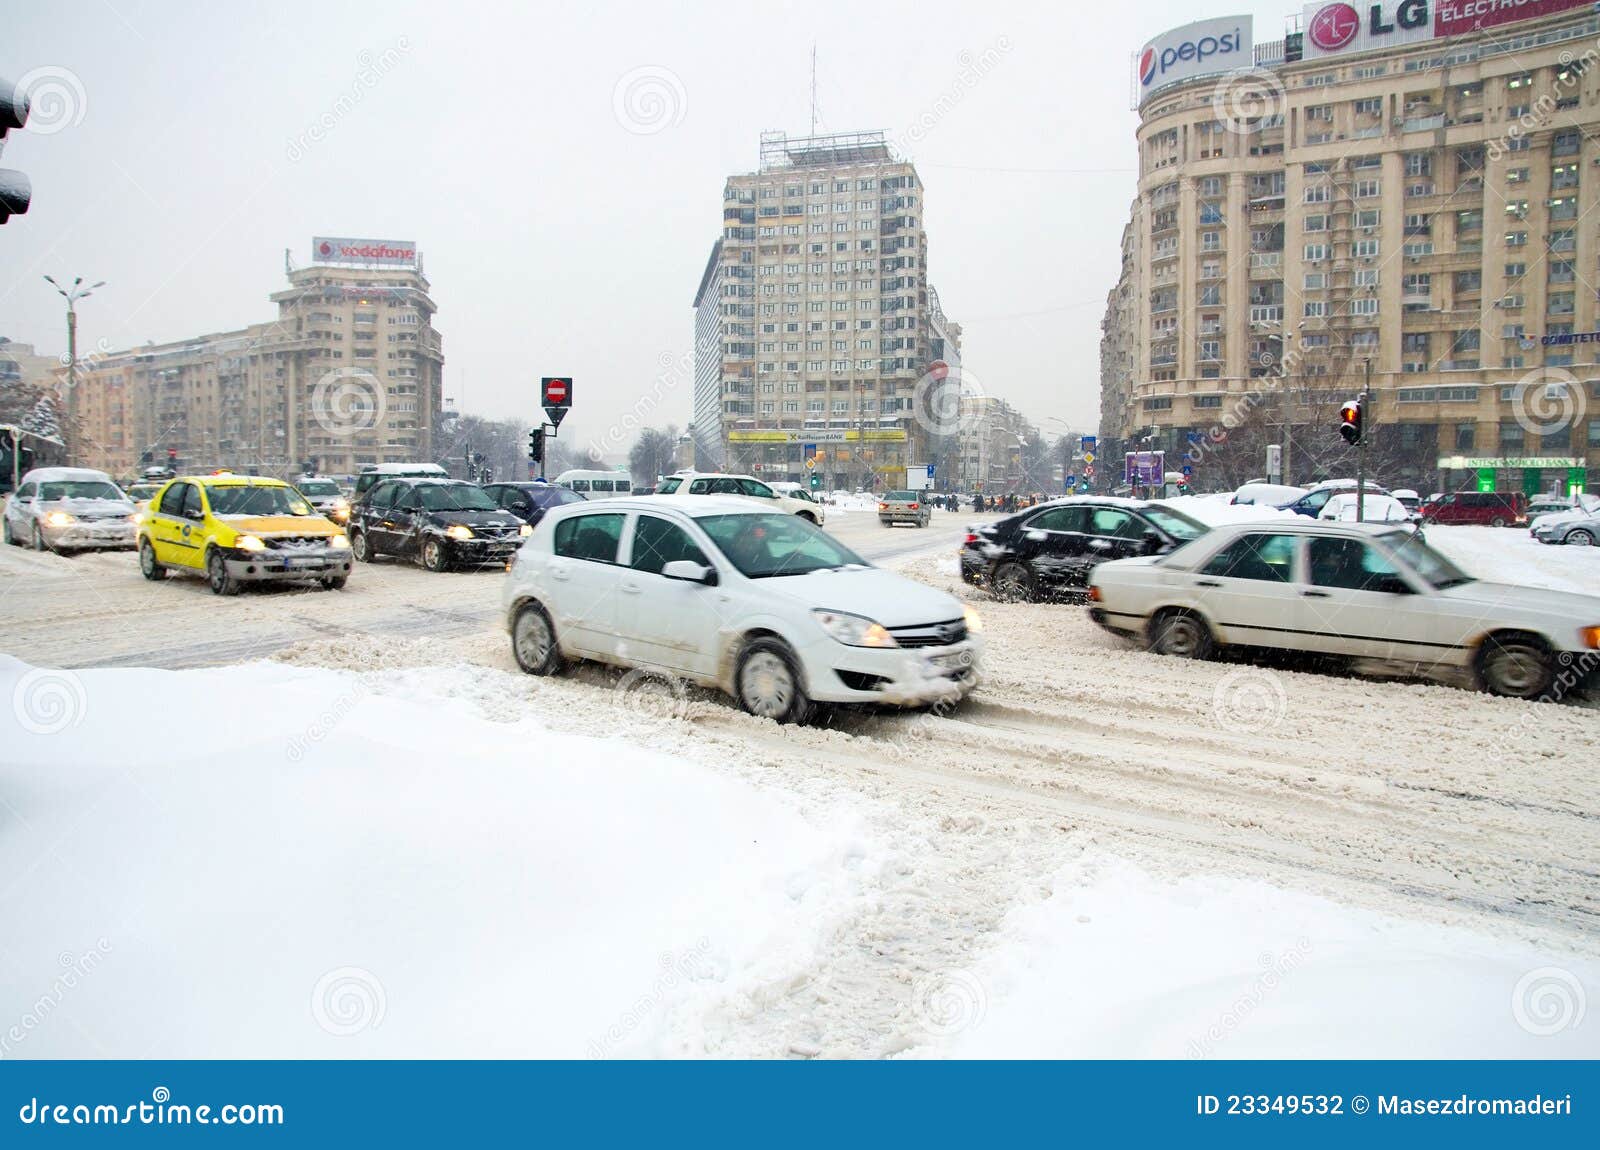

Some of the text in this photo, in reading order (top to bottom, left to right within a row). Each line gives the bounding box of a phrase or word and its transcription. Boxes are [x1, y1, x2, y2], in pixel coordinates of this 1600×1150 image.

[1370, 0, 1428, 35] LG
[1441, 0, 1542, 22] ELECTR
[1160, 27, 1240, 74] pepsi
[341, 244, 414, 259] vodafone
